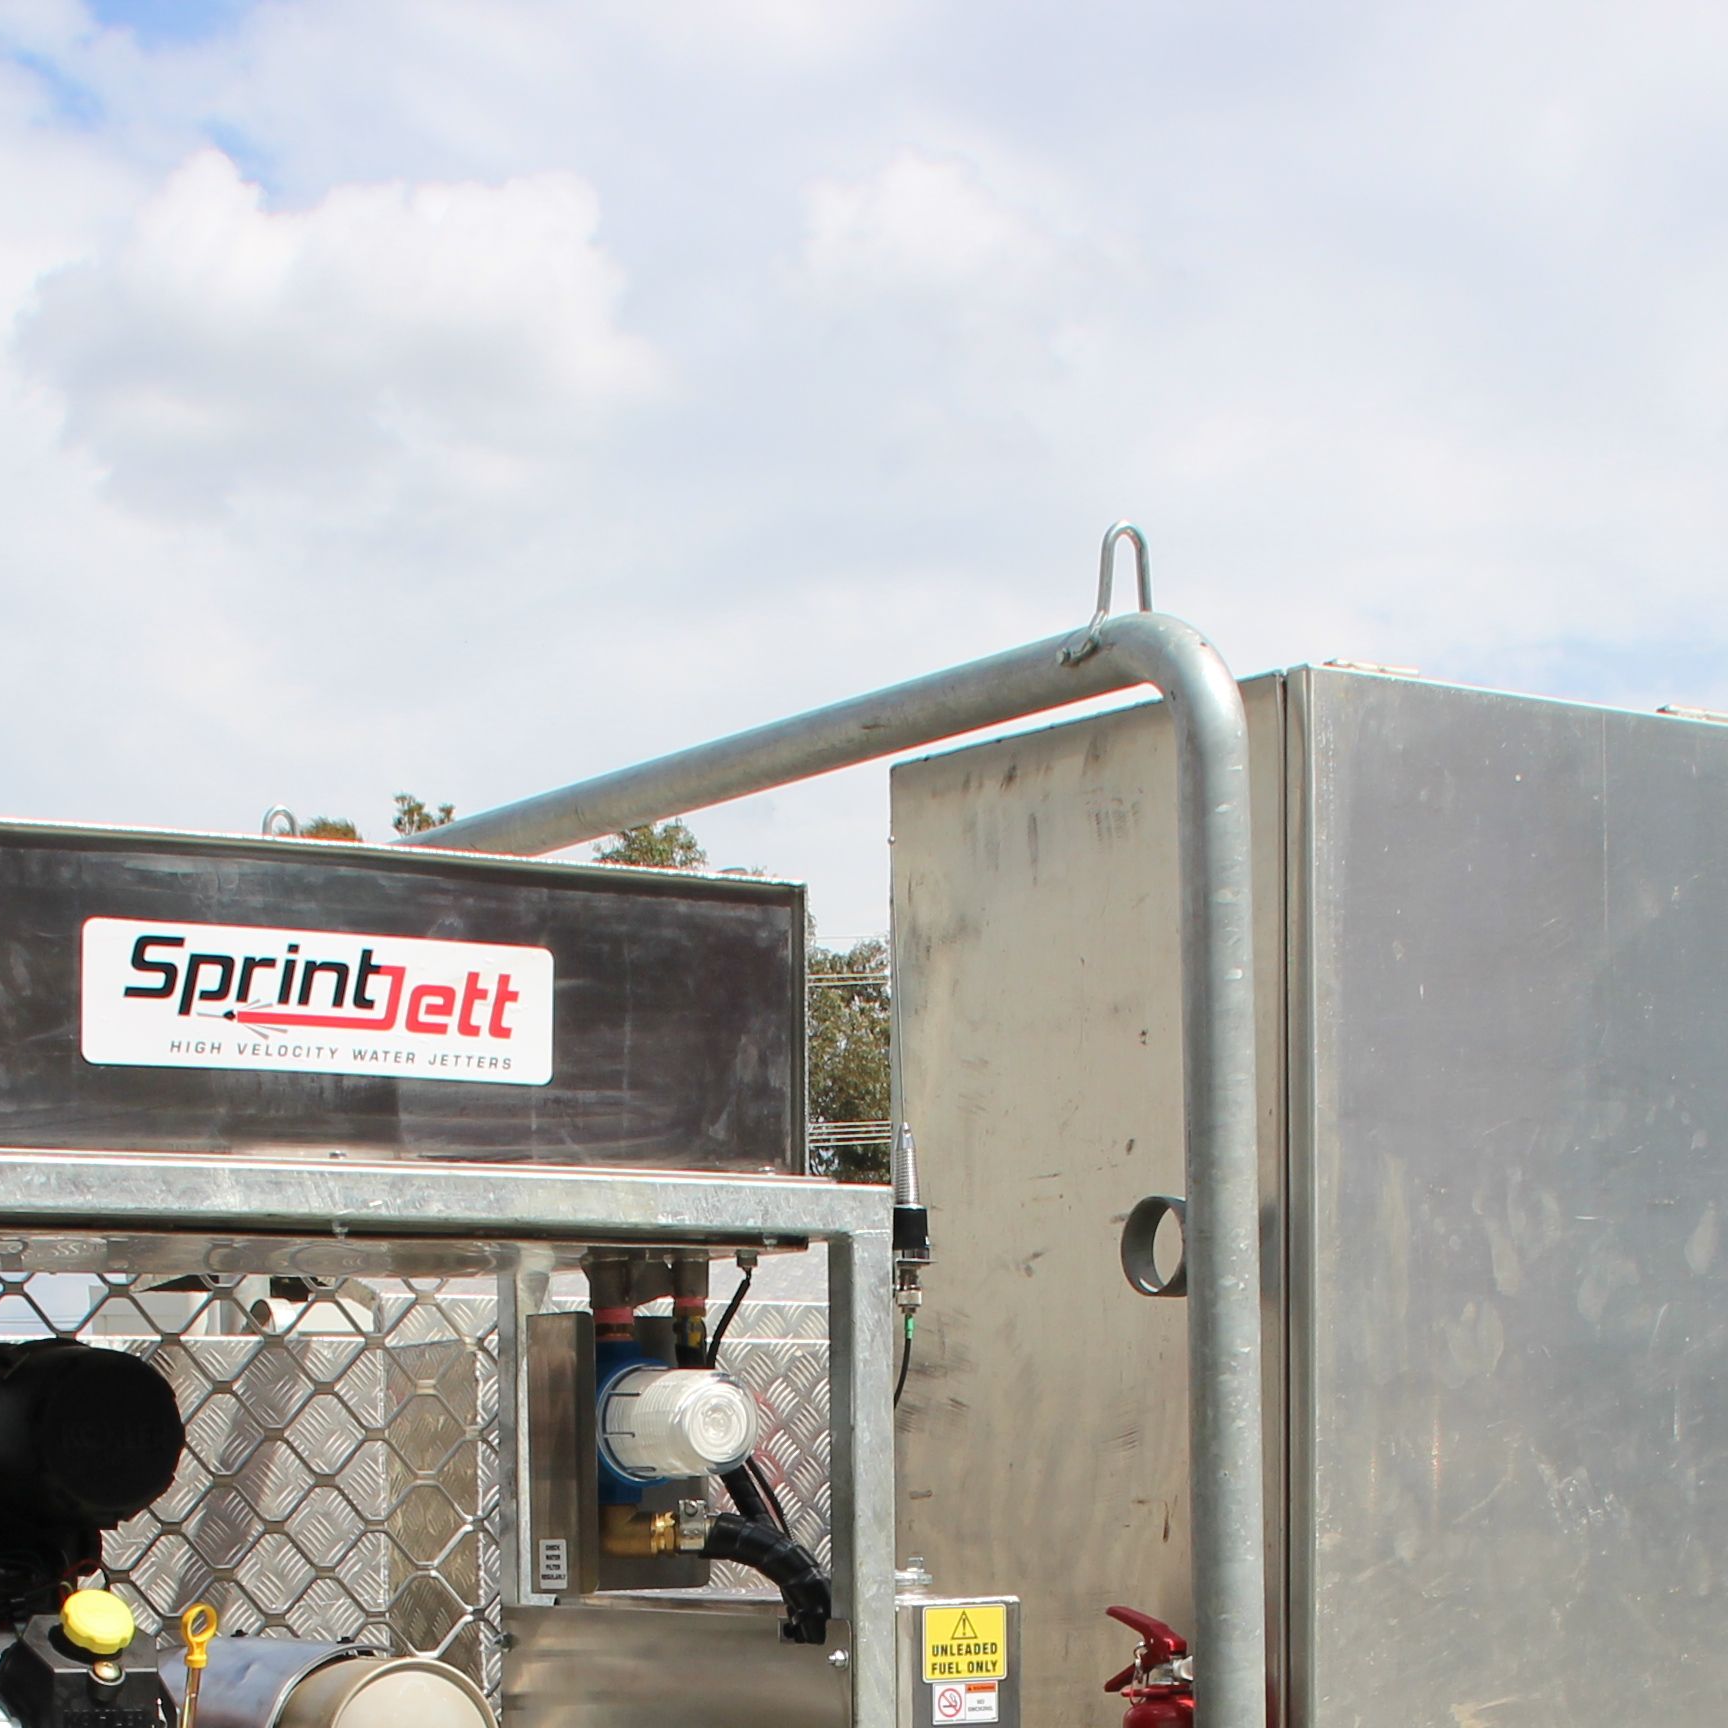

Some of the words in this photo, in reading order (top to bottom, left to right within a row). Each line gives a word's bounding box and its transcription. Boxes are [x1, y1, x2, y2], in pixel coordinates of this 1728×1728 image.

[170, 1040, 223, 1055] HIGH
[237, 1043, 340, 1060] VELOCITY
[352, 1048, 417, 1065] WATER
[427, 1051, 513, 1070] JETTERS
[931, 1642, 998, 1657] UNLEADED
[931, 1661, 962, 1675] FUEL
[967, 1660, 998, 1673] ONLY
